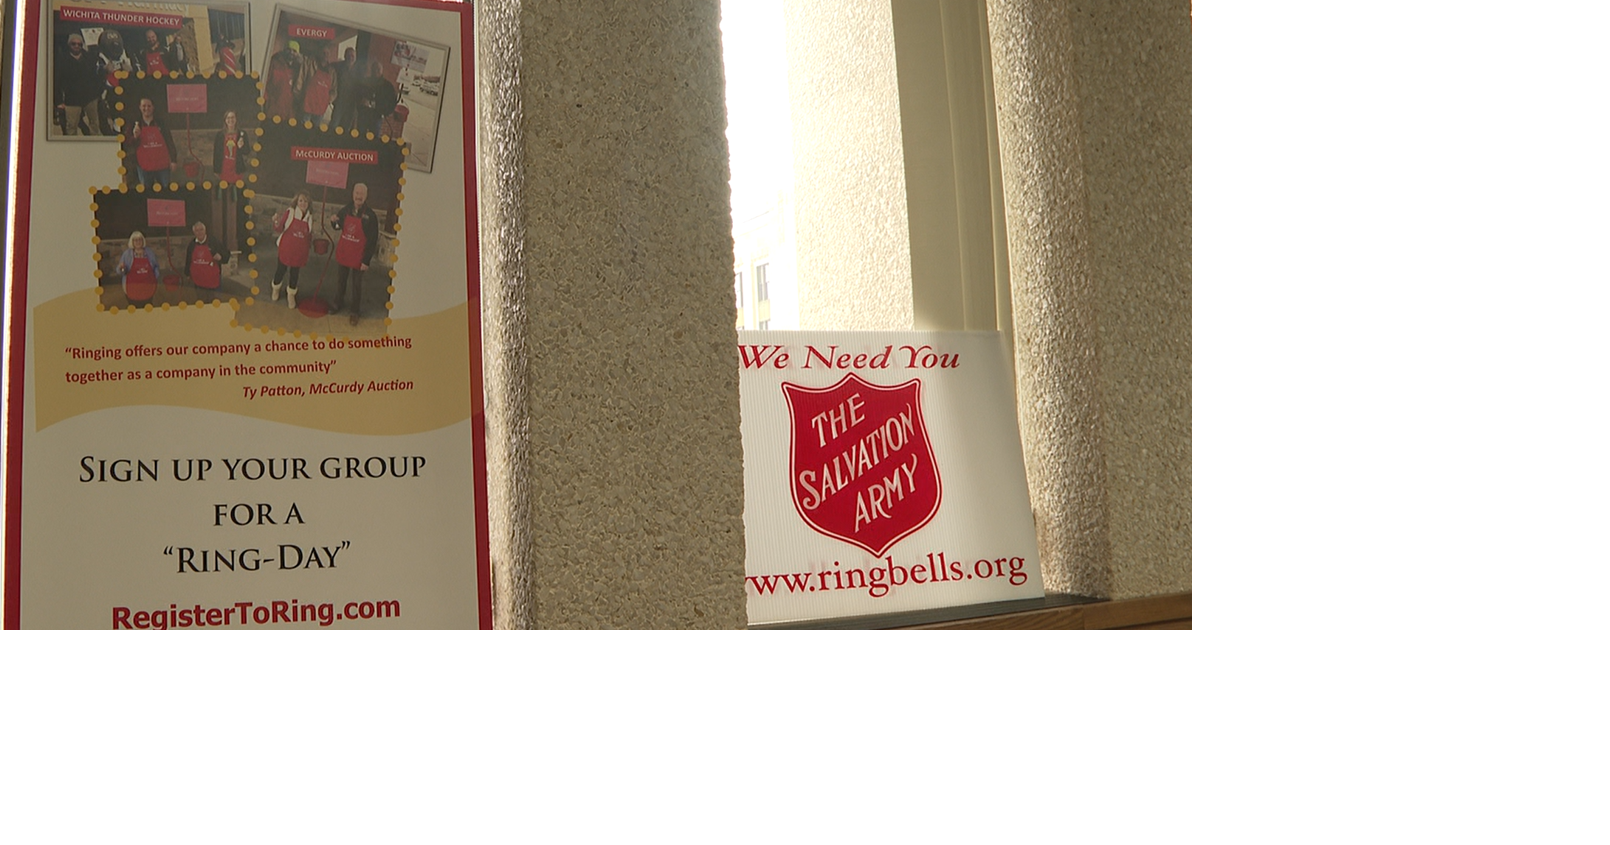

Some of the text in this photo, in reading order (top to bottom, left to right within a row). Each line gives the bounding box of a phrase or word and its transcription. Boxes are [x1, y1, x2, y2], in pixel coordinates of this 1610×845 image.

[62, 9, 180, 26] WICHITA THUNDER HOCKEY
[296, 27, 328, 38] EVERGY
[295, 149, 374, 162] McCURDY AUCTION
[125, 344, 163, 357] offers
[166, 346, 188, 356] our
[192, 344, 250, 356] company
[254, 343, 261, 352] a
[265, 340, 309, 352] chance
[312, 339, 325, 350] to
[329, 338, 344, 349] do
[348, 336, 412, 349] something
[737, 343, 961, 369] We Need You
[65, 368, 123, 385] together
[127, 370, 141, 380] as
[145, 370, 152, 379] a
[156, 367, 216, 380] company
[219, 365, 231, 376] in
[234, 364, 256, 376] the
[243, 379, 413, 400] Ty Patton, McCurdy Auction
[811, 392, 866, 449] THE
[799, 402, 916, 510] SALVATION
[79, 455, 426, 483] SIGN UP YOUR GROUP
[853, 452, 918, 534] ARMY
[213, 502, 306, 527] FOR A
[744, 552, 1028, 598] ww.ringbells.org
[111, 599, 401, 630] RegisterToRing.com
